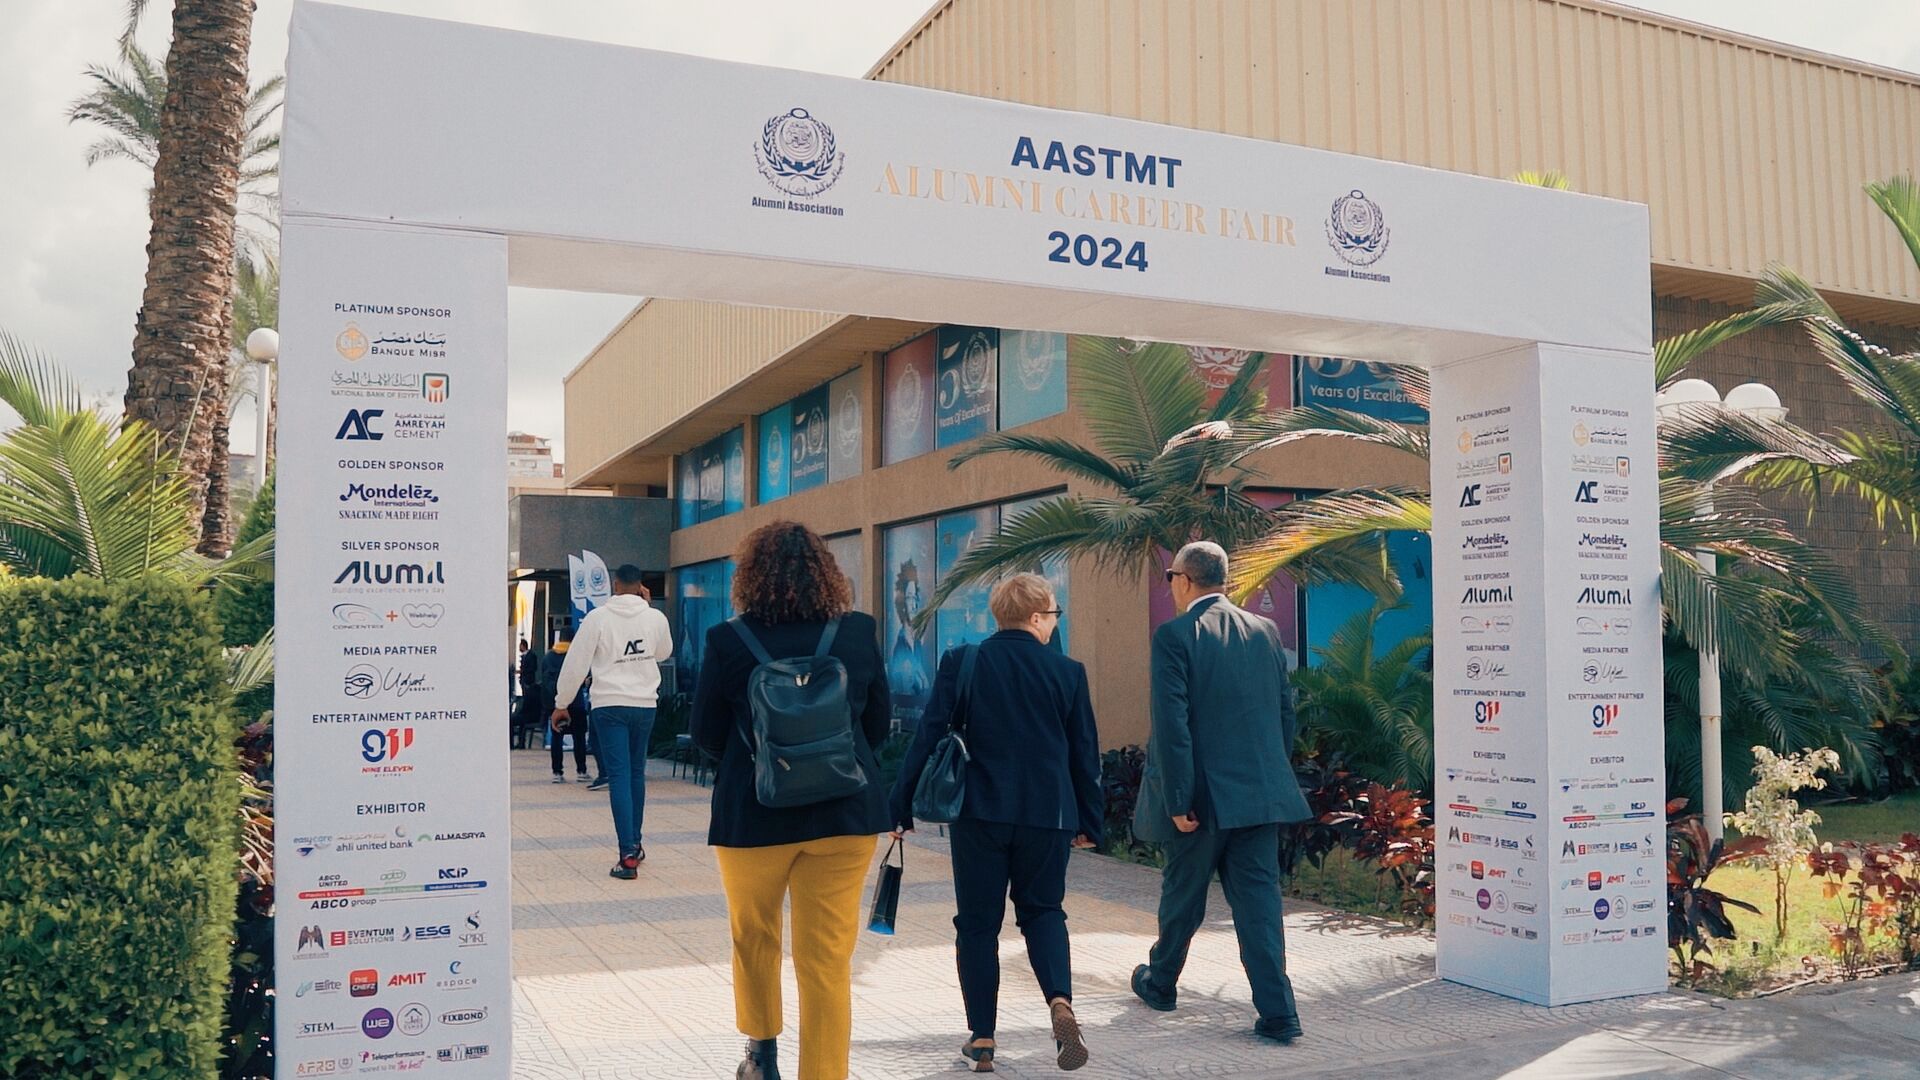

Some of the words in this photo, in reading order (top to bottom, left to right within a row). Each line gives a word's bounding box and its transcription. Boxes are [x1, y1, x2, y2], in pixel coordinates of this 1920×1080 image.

[1011, 136, 1182, 188] AASTMT
[752, 196, 786, 209] Alumni
[788, 200, 844, 216] Association
[874, 162, 1042, 214] ALUMNI
[1055, 185, 1207, 235] CAREER
[1219, 207, 1296, 247] FAIR
[1048, 231, 1148, 272] 2024
[334, 303, 394, 315] PLATINUM
[397, 307, 452, 318] SPONSOR
[371, 346, 415, 356] BANQUE
[331, 390, 364, 398] NATIONAL
[366, 391, 386, 399] BANK
[1310, 385, 1343, 398] Years
[1346, 386, 1360, 402] Of
[1363, 389, 1418, 404] Excellen
[1456, 411, 1484, 422] PLATINUM
[1485, 406, 1511, 418] SPONSOR
[1571, 405, 1600, 415] PLATINUM
[1602, 408, 1629, 418] SPONSOR
[334, 408, 385, 441] AC
[394, 420, 445, 429] AMREYAH
[394, 430, 440, 439] CEMENT
[338, 459, 386, 469] GOLDEN
[389, 461, 444, 471] SPONSOR
[1459, 484, 1481, 508] AC
[1575, 480, 1599, 503] AC
[338, 510, 383, 520] SNACKING
[385, 511, 410, 520] MADE
[412, 511, 439, 521] RIGHT
[1461, 518, 1483, 527] GOLDEN
[1484, 515, 1511, 525] SPONSOR
[1577, 516, 1600, 524] GOLDEN
[1602, 517, 1629, 526] SPONSOR
[341, 541, 381, 551] SILVER
[384, 542, 440, 551] SPONSOR
[1483, 572, 1510, 581] SPONSOR
[1580, 573, 1599, 581] SILVER
[1601, 573, 1629, 582] SPONSOR
[343, 646, 382, 656] MEDIA
[384, 645, 437, 655] PARTNER
[623, 639, 645, 656] AC
[1466, 644, 1483, 652] MEDIA
[1484, 644, 1510, 652] PARTNER
[1453, 688, 1499, 697] ENTERTAINMENT
[1500, 689, 1527, 698] PARTNER
[1618, 692, 1645, 700] PARTNER
[312, 712, 412, 724] ENTERTAINMENT
[415, 710, 467, 720] PARTNER
[1473, 750, 1506, 760] EXHIBITOR
[1590, 756, 1625, 765] EXHIBITOR
[383, 765, 414, 773] ELEVEN
[356, 802, 426, 816] EXHIBITOR
[434, 831, 487, 842] ALMASRYA
[336, 843, 354, 852] ahli
[356, 841, 387, 851] united
[389, 840, 414, 849] bank
[310, 898, 349, 910] ABCO
[351, 898, 377, 908] group
[348, 928, 395, 939] EVENTUM
[415, 925, 451, 937] ESG
[349, 936, 395, 945] SOLUTIONS
[387, 972, 427, 988] AMIT
[436, 977, 477, 989] espace
[443, 1012, 484, 1023] FIXBOND
[304, 1022, 334, 1034] STEM
[371, 1050, 426, 1061] Teleperformance
[296, 1060, 336, 1075] AFRO
